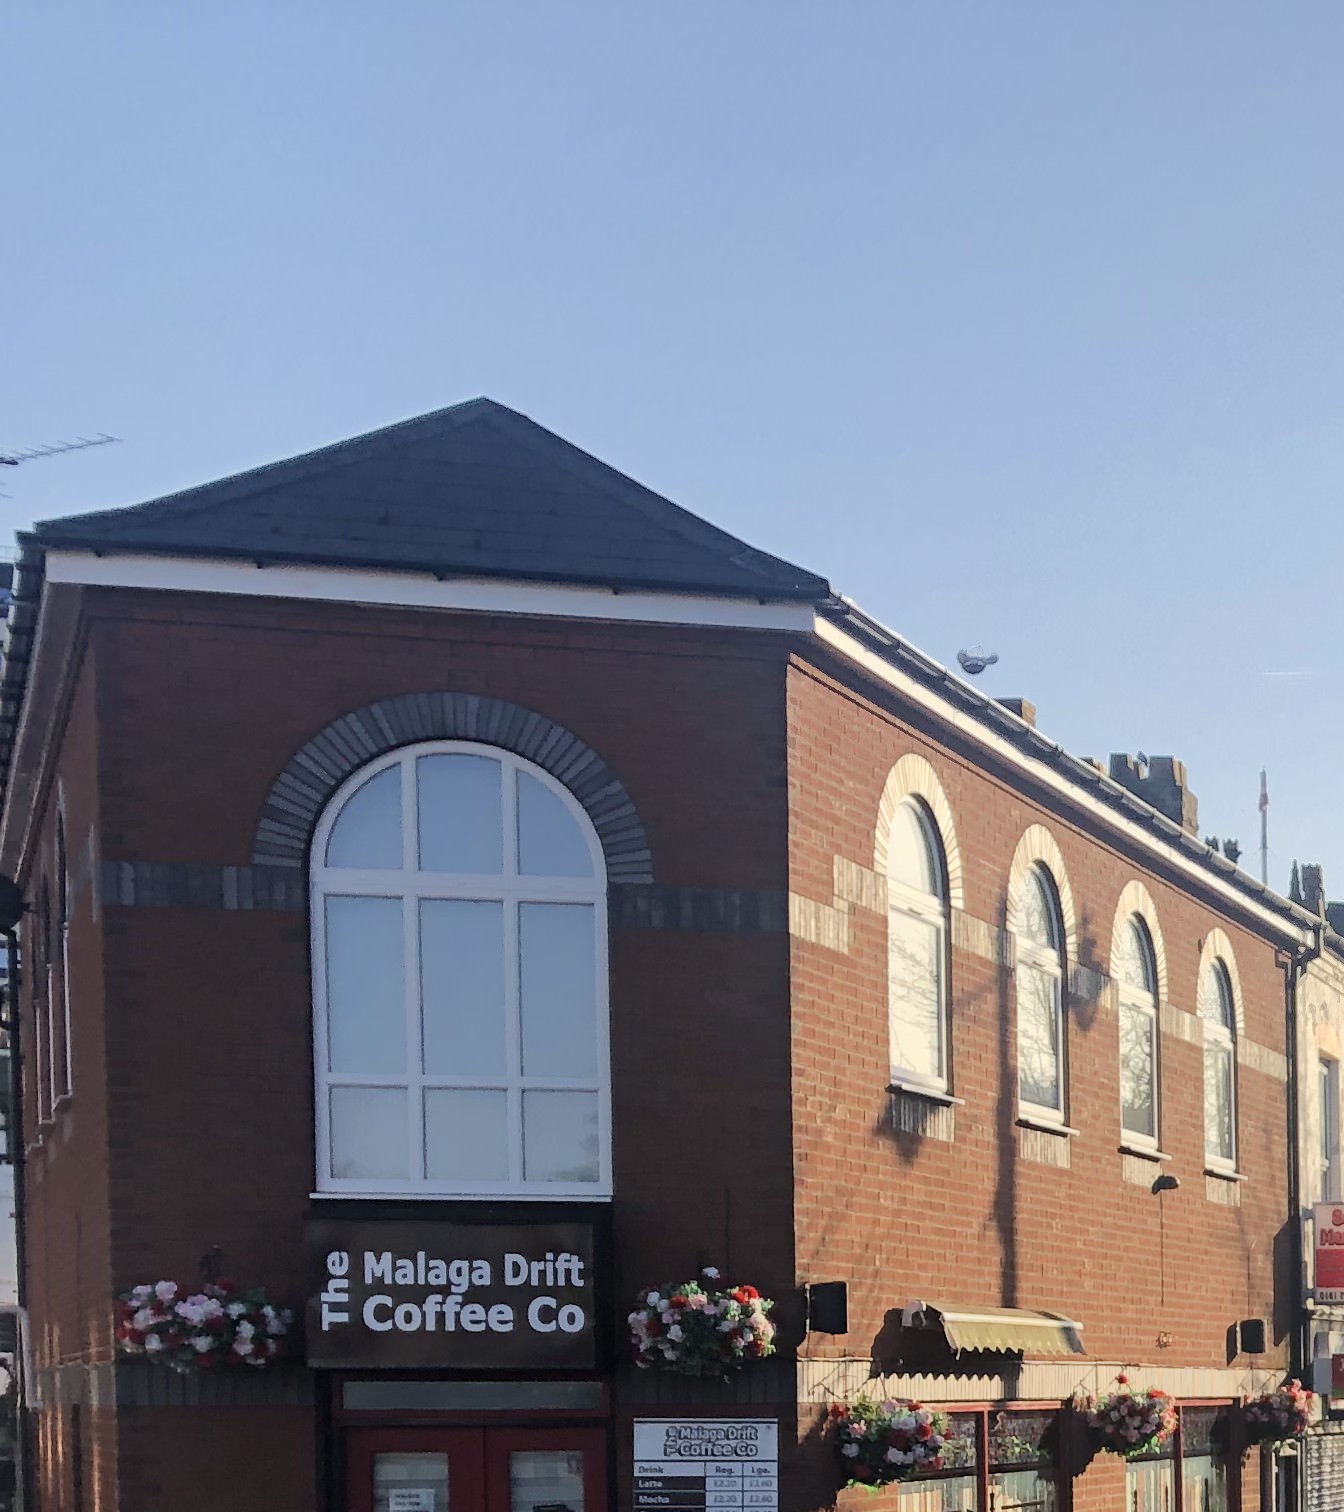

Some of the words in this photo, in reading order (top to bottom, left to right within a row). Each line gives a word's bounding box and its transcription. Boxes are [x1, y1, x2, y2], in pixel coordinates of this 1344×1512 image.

[321, 1250, 349, 1331] The
[363, 1251, 491, 1293] Malaga
[504, 1252, 585, 1287] Drift
[362, 1294, 514, 1332] Coffee
[528, 1296, 585, 1333] Co
[678, 1441, 734, 1456] Coffee
[735, 1442, 758, 1456] Co
[679, 1426, 725, 1440] Malaga
[727, 1426, 758, 1440] Drift
